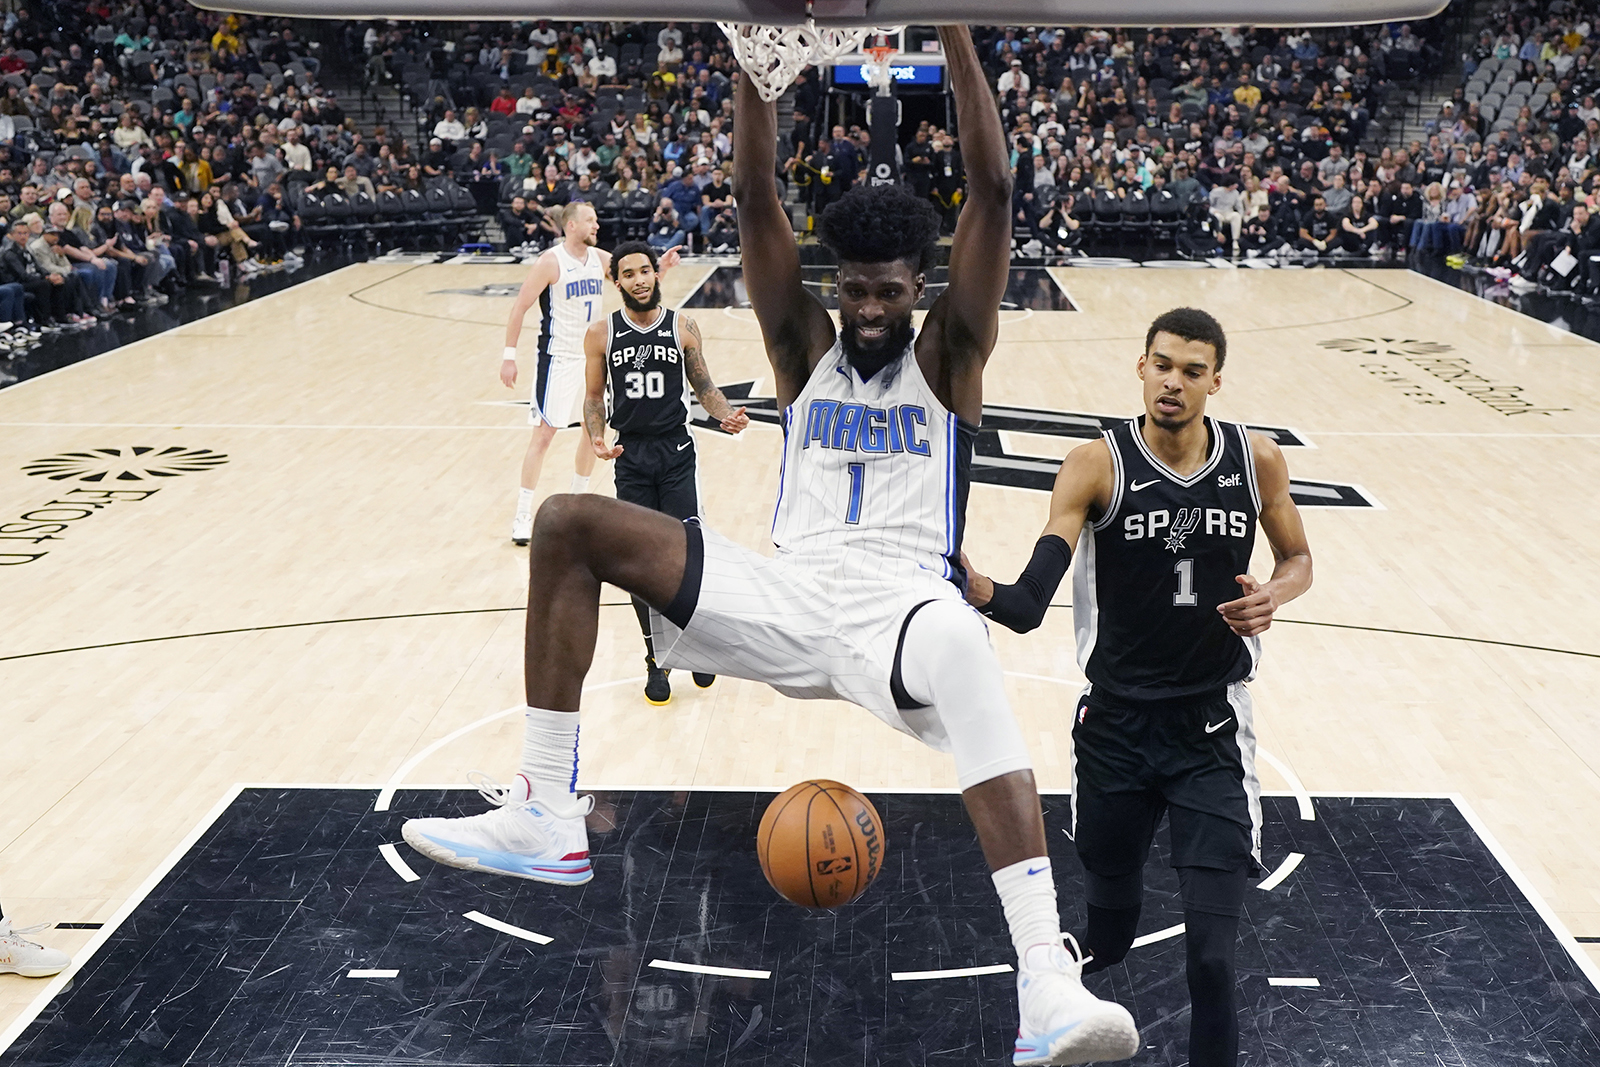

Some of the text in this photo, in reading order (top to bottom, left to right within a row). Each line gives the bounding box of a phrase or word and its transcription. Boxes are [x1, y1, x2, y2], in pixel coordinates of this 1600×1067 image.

[584, 301, 593, 323] 7
[611, 344, 679, 370] SPURS
[624, 370, 666, 400] 30
[1360, 364, 1446, 406] CENTER
[802, 399, 932, 457] MAGIC
[844, 462, 866, 525] 1
[1217, 473, 1243, 488] Self.
[1124, 507, 1248, 553] SPURS
[1173, 558, 1198, 607] 1
